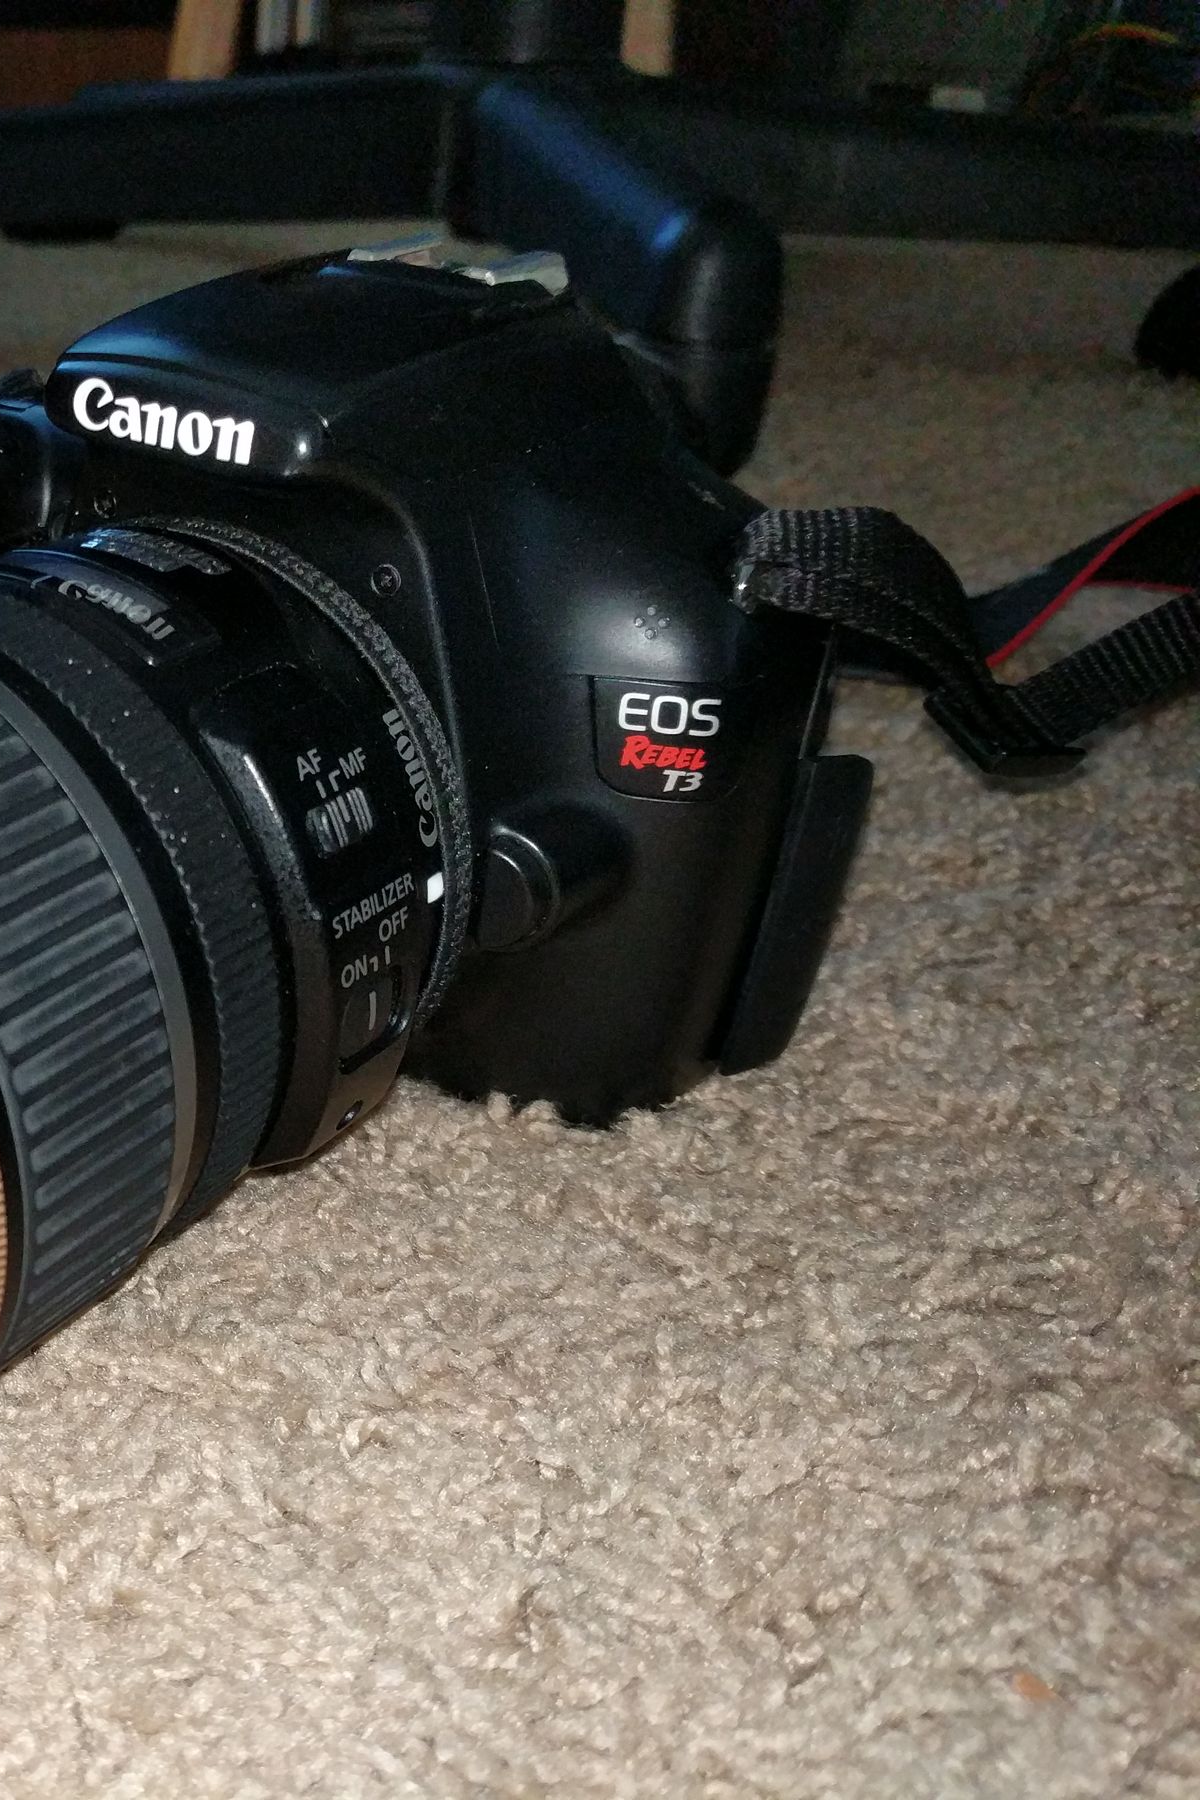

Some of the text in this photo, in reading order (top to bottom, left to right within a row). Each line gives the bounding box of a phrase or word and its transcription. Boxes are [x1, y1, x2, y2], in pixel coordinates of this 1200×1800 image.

[73, 378, 255, 466] Canon
[618, 692, 722, 737] EOS
[296, 746, 367, 782] AF MF
[619, 735, 707, 770] REBEL
[382, 708, 438, 848] Canon
[662, 769, 705, 793] T3
[332, 872, 415, 940] STABILIZER
[378, 905, 409, 943] OFF
[340, 954, 368, 989] ON
